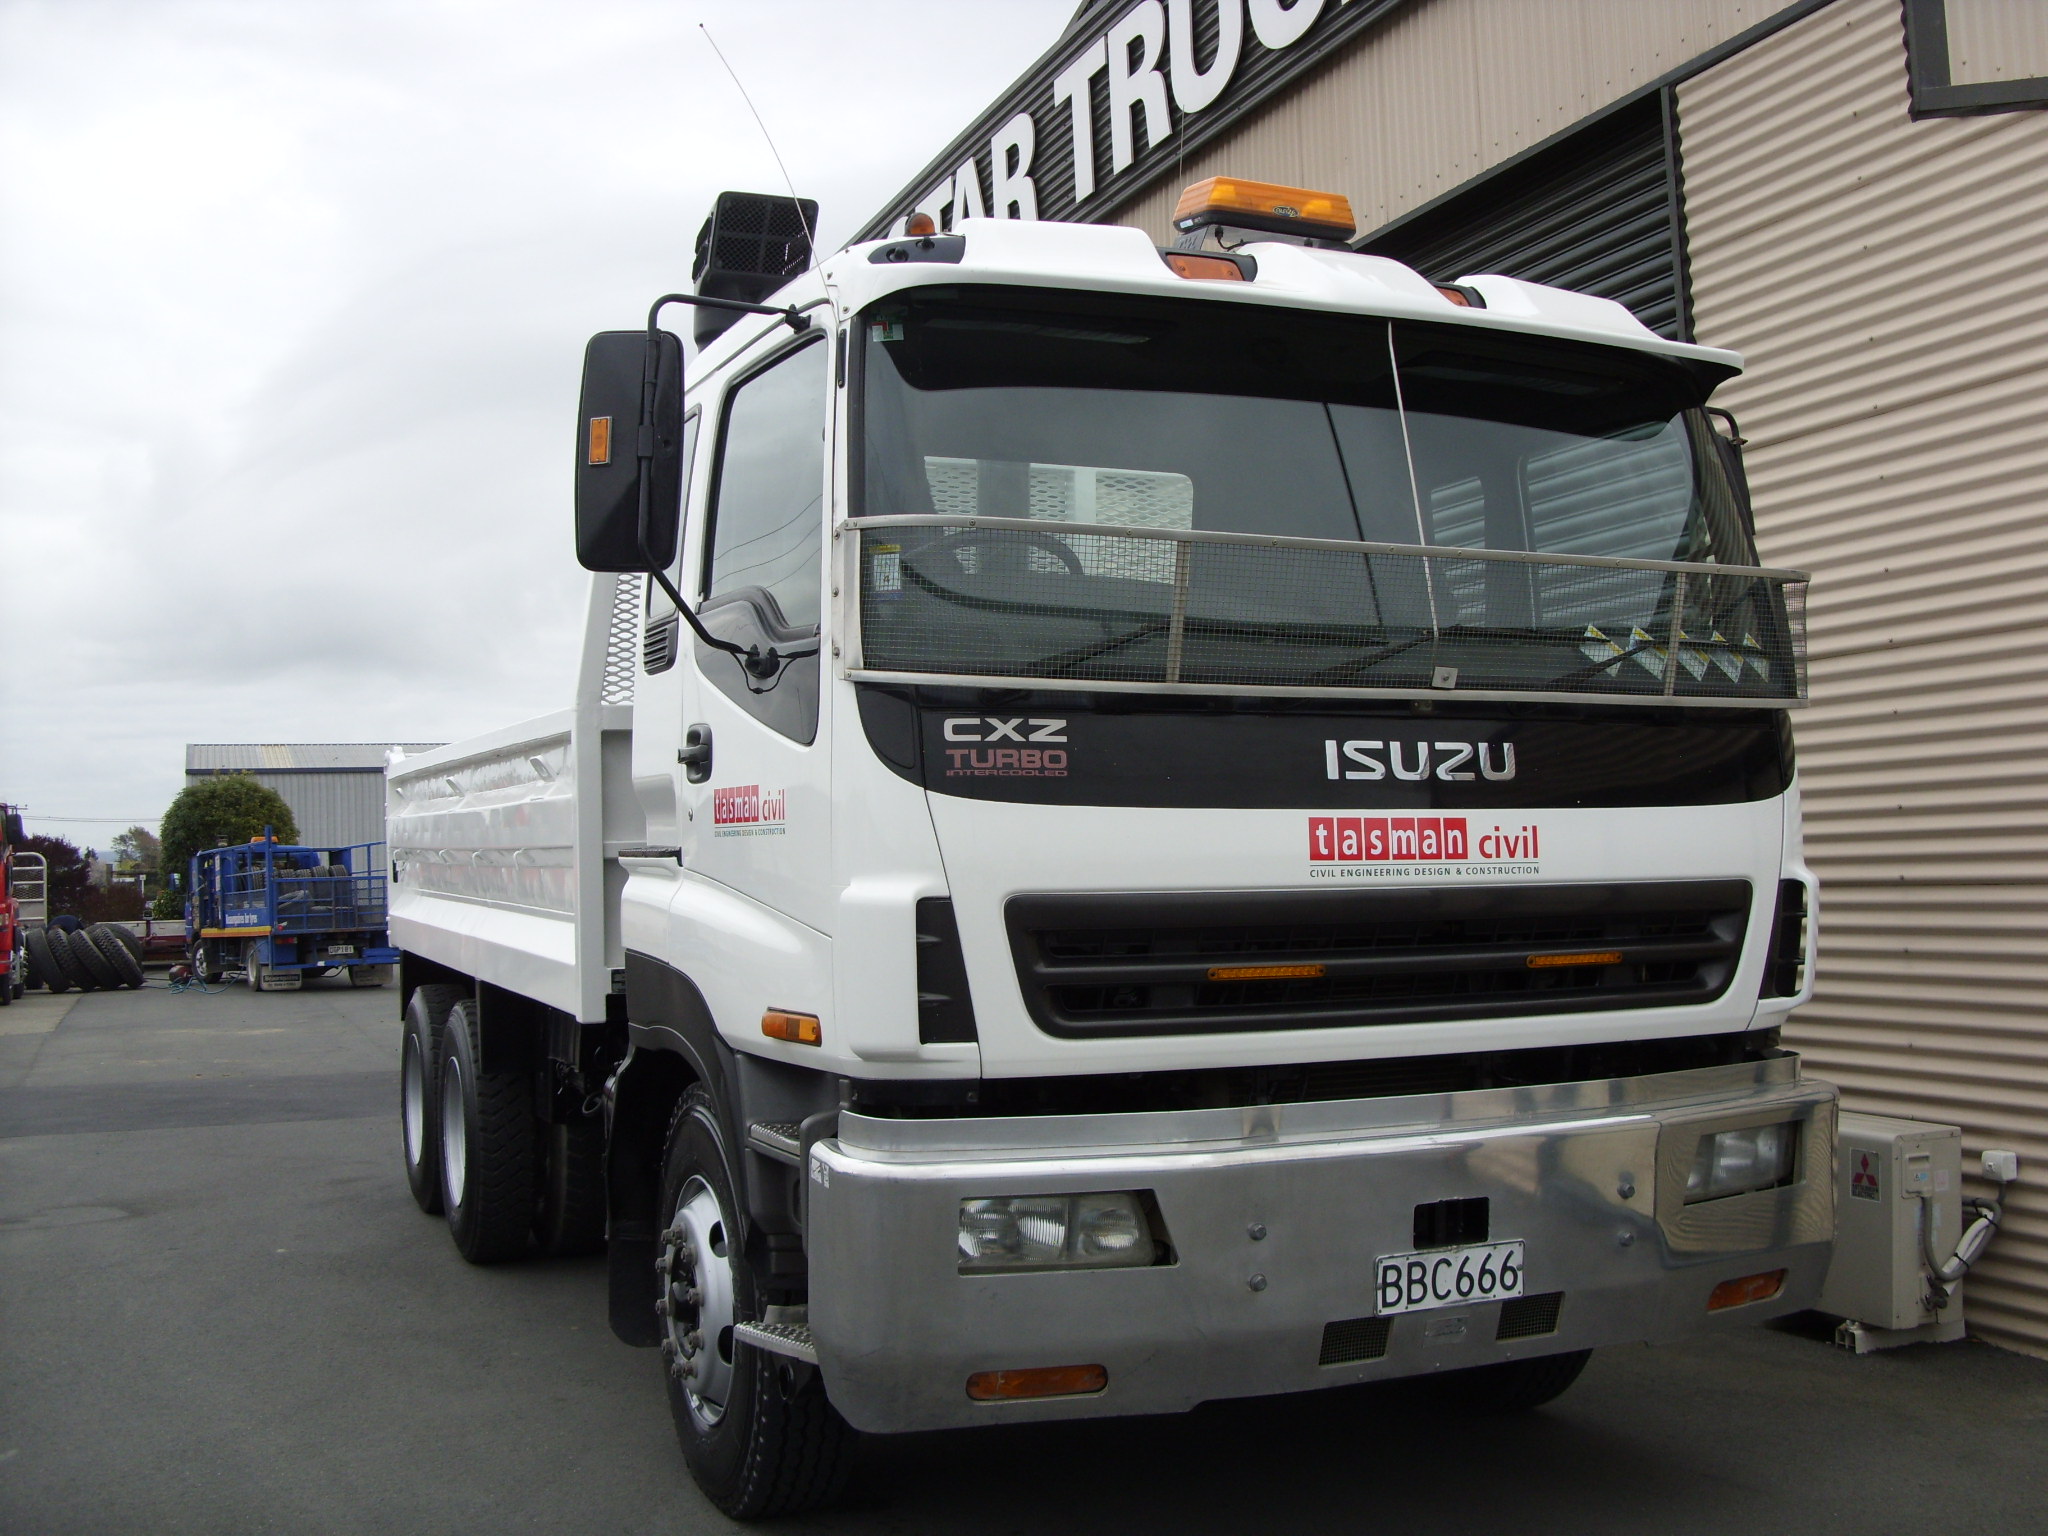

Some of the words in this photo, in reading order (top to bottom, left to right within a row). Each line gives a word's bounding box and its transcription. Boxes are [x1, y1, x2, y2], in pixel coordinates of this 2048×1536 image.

[1054, 0, 1350, 203] TRU
[943, 717, 1068, 743] CXZ
[945, 748, 1068, 769] TURBO
[946, 769, 1068, 777] INTERCOOLED
[1324, 739, 1516, 781] ISUZU
[714, 792, 758, 820] tasman
[762, 788, 785, 821] civil
[1314, 822, 1465, 857] tasman
[1478, 825, 1539, 859] civil
[1310, 868, 1336, 878] CIVIL
[1340, 867, 1410, 877] ENGINEERING
[1414, 867, 1451, 876] DESIGN
[1455, 867, 1463, 876] &
[1465, 866, 1540, 875] CONSTRUCTION
[1381, 1250, 1519, 1309] BBC666
